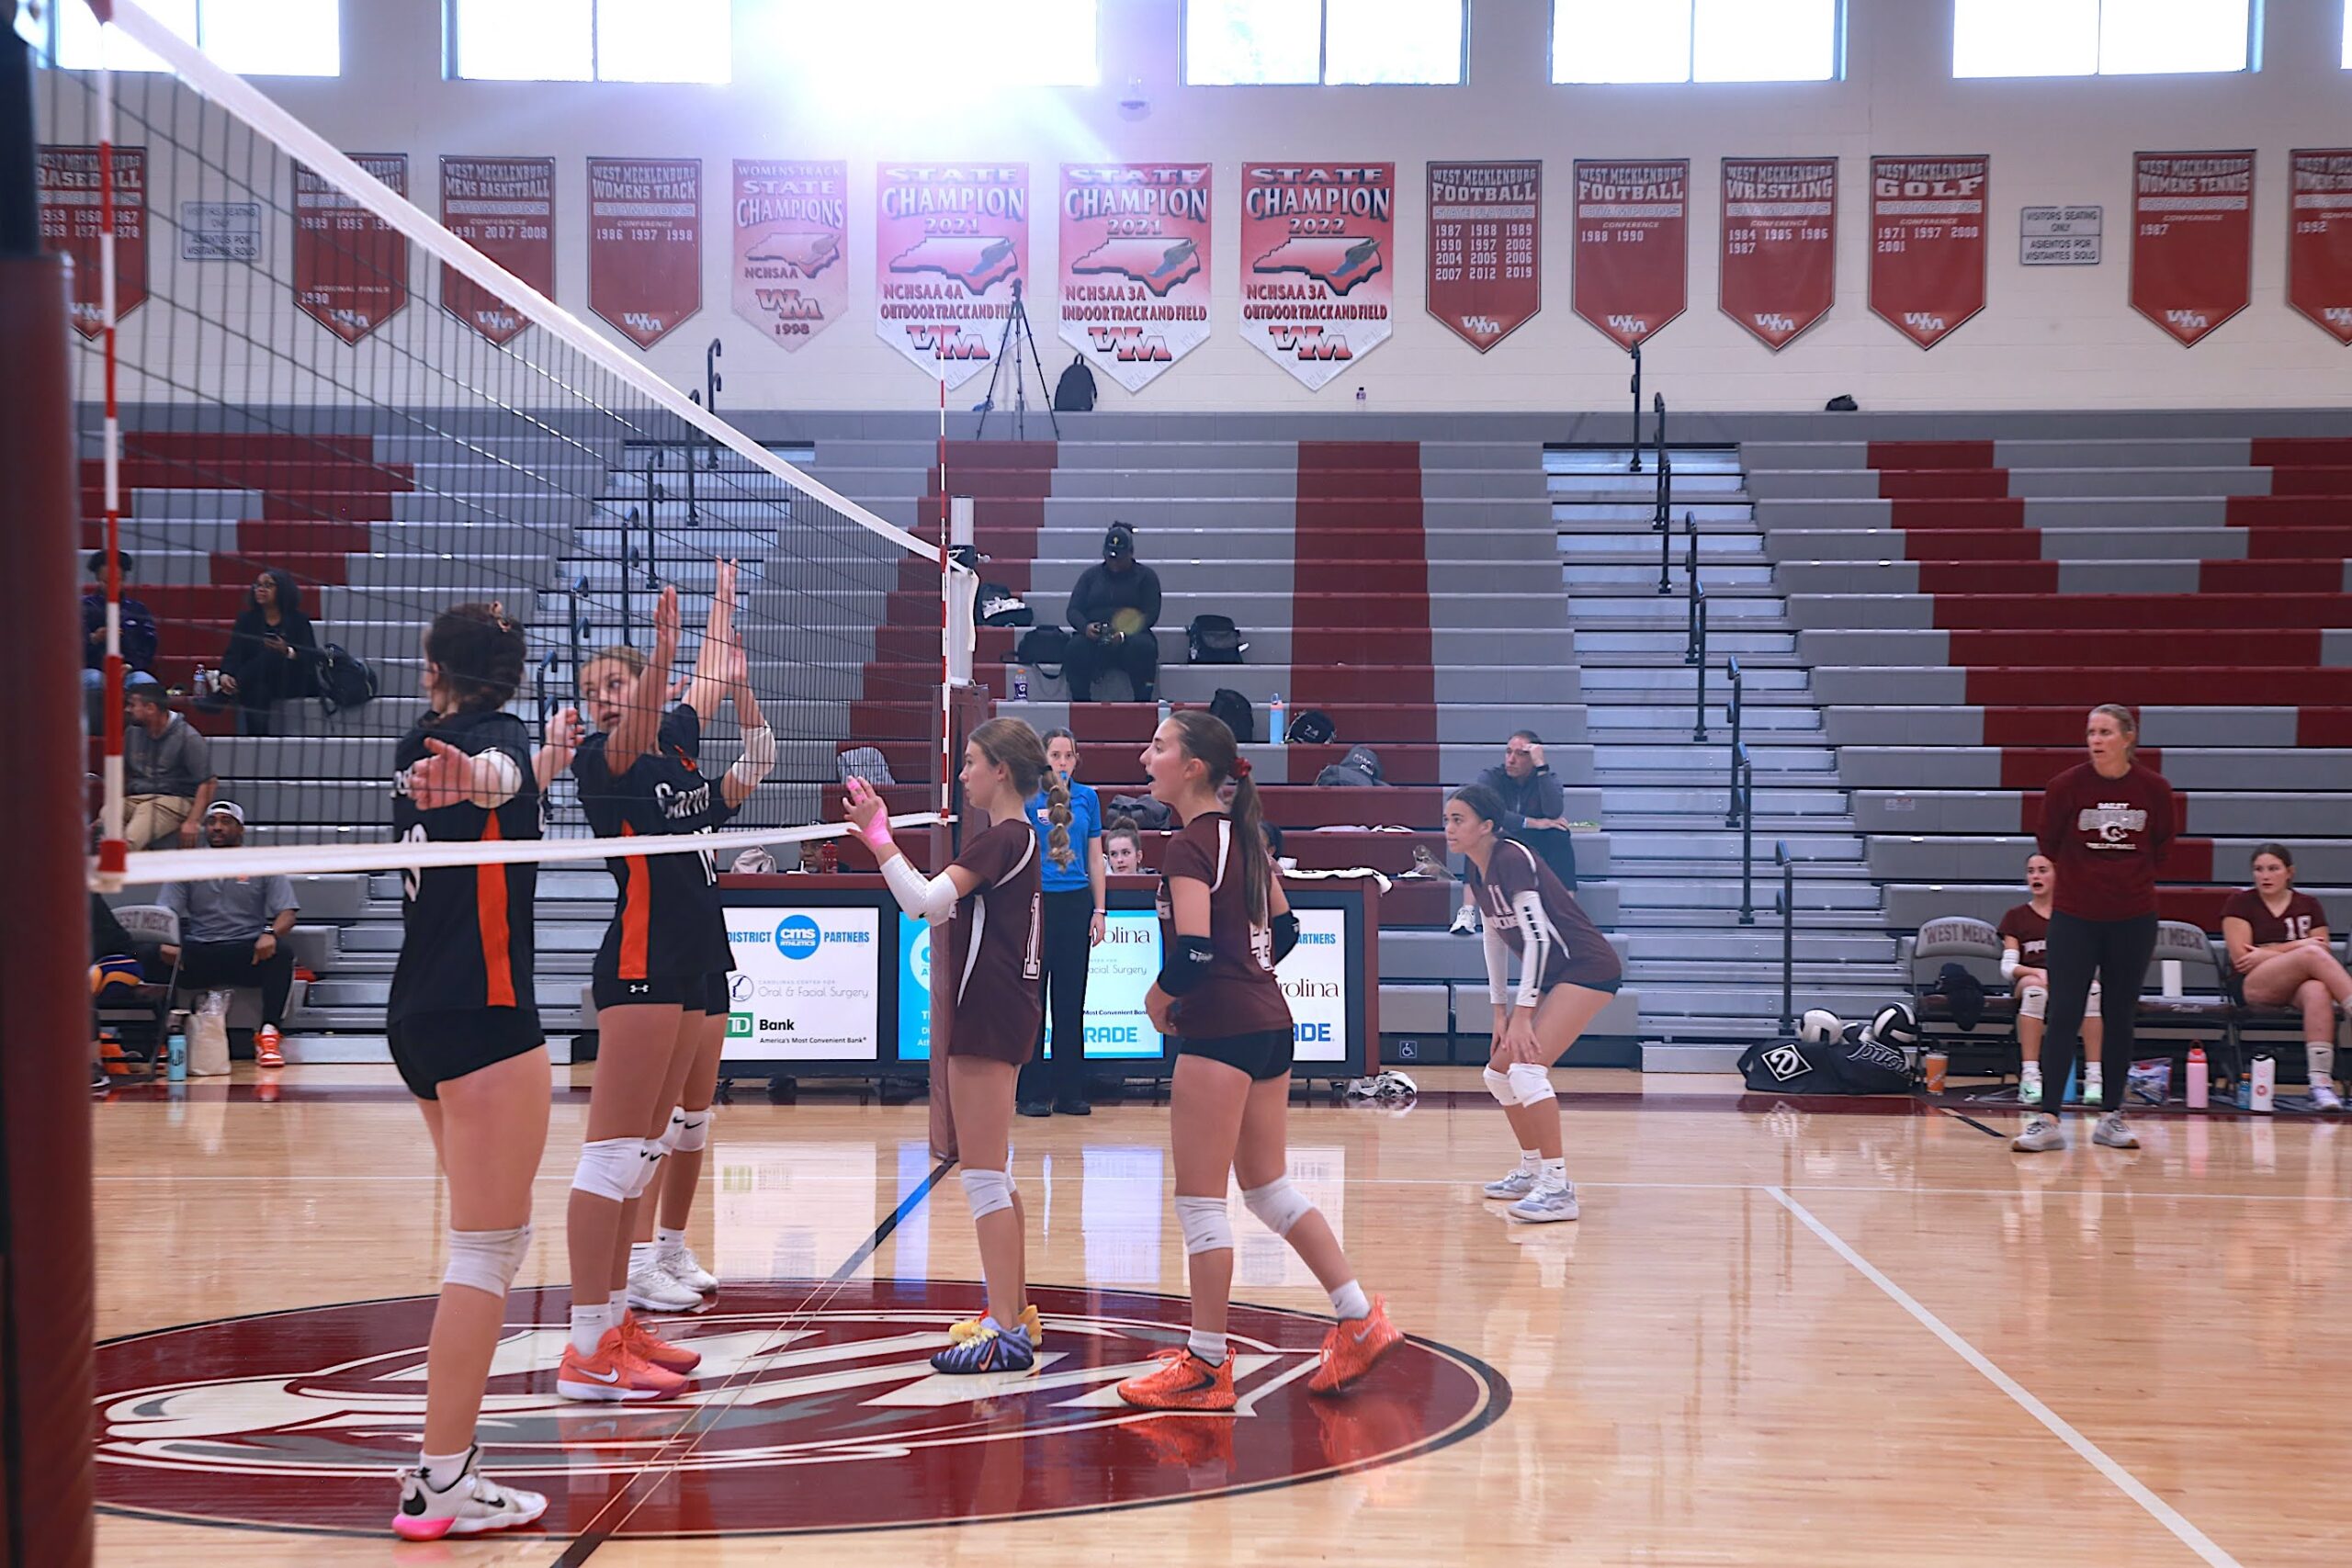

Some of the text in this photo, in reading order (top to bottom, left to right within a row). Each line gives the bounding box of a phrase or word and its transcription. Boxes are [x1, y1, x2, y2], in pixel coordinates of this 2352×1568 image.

[37, 167, 141, 187] BASEBLL
[446, 164, 549, 181] WEST MECKLENBURG
[593, 166, 695, 184] WEST MECKLENBURG
[739, 165, 840, 176] WOMENS TRACK
[886, 168, 1018, 184] STATE
[1069, 169, 1203, 185] STATE
[1250, 168, 1385, 185] STATE
[1433, 169, 1536, 186] WEST MECKLENBURG
[1580, 167, 1684, 185] WEST MECKLENBURG
[1727, 166, 1757, 182] WEST
[446, 176, 549, 197] MENS BASKETBALL
[593, 178, 695, 199] WOMENS TRACK
[743, 180, 836, 195] STATE
[1432, 183, 1536, 201] FOOTBALL
[1579, 181, 1684, 200] FOOTBALL
[1727, 178, 1833, 199] WRESTLING
[1875, 175, 1984, 197] GOLF
[448, 202, 548, 214] CHAMPIONS
[596, 204, 693, 215] CHAMPIONS
[881, 187, 1024, 220] CHAMPION
[1064, 188, 1207, 222] CHAMPION
[1246, 187, 1390, 222] CHAMPION
[1582, 205, 1680, 217] CHAMPIONS
[737, 198, 843, 229] CHAMPIONS
[1435, 207, 1532, 219] STATE PLAYOFFS
[520, 226, 548, 239] 2008
[925, 218, 979, 233] 2021
[1107, 219, 1162, 235] 2021
[1289, 218, 1345, 234] 2022
[1436, 224, 1532, 236] 1987 1988 1989
[596, 229, 693, 241] 1986 1997 1998
[1582, 231, 1644, 242] 1988 1990
[1729, 229, 1757, 241] 1984
[1436, 239, 1532, 251] 1990 1997 2002
[1729, 243, 1757, 254] 1987
[1436, 252, 1532, 265] 2004 2005 2006
[744, 266, 798, 279] NCHSAA
[1436, 266, 1532, 280] 2007 2012 2019
[883, 284, 964, 299] NCHSAA 4A
[1066, 286, 1147, 301] NCHSAA 3A
[1247, 284, 1328, 299] NCHSAA 3A
[775, 323, 809, 334] 1998
[727, 931, 869, 942] DISTRICT PARTNERS
[780, 928, 816, 940] cms
[1102, 926, 1150, 944] olina
[1296, 933, 1336, 944] ARTNERS
[1925, 924, 1996, 946] WEST MECK
[1088, 964, 1109, 975] acial
[758, 987, 782, 997] Oral
[786, 987, 794, 997] &
[830, 987, 869, 998] Surgery
[1279, 978, 1339, 998] rolina
[728, 1017, 795, 1032] TD Bank
[1084, 1027, 1138, 1043] RADE
